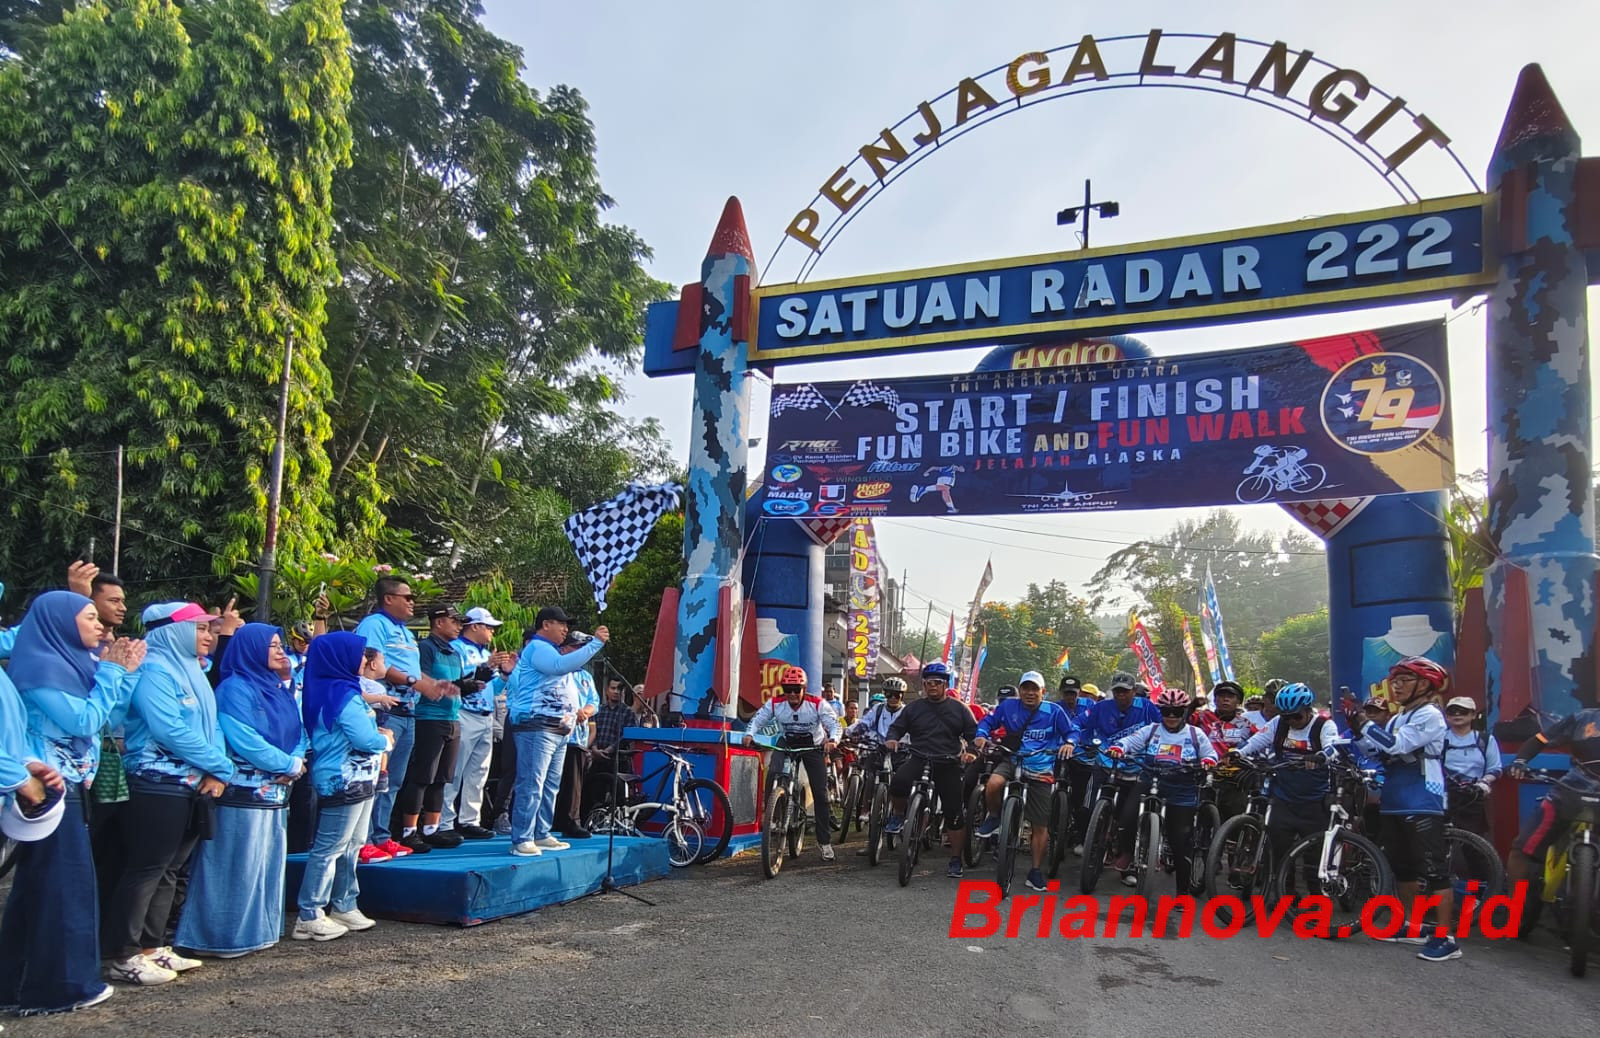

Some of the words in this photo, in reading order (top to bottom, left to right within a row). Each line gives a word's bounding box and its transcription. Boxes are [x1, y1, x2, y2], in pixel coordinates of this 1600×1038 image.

[785, 34, 1109, 250] PENJAGA
[1139, 29, 1452, 172] LANGIT
[776, 276, 1001, 338] SATUAN
[1031, 245, 1262, 313] RADAR
[1306, 216, 1453, 282] 222
[895, 393, 1032, 434] START
[1053, 390, 1068, 424] /
[1090, 375, 1260, 422] FINISH
[993, 372, 1097, 391] ANGKATAN
[1113, 363, 1179, 380] UDARA
[1351, 376, 1416, 431] 79
[856, 434, 923, 461] FUN
[940, 428, 1022, 458] BIKE
[1034, 431, 1089, 453] AND
[1097, 416, 1170, 449] FUN
[1186, 406, 1307, 443] WALK
[974, 454, 1071, 471] JELAJAH
[1087, 447, 1181, 466] ALASKA
[855, 613, 870, 678] 222
